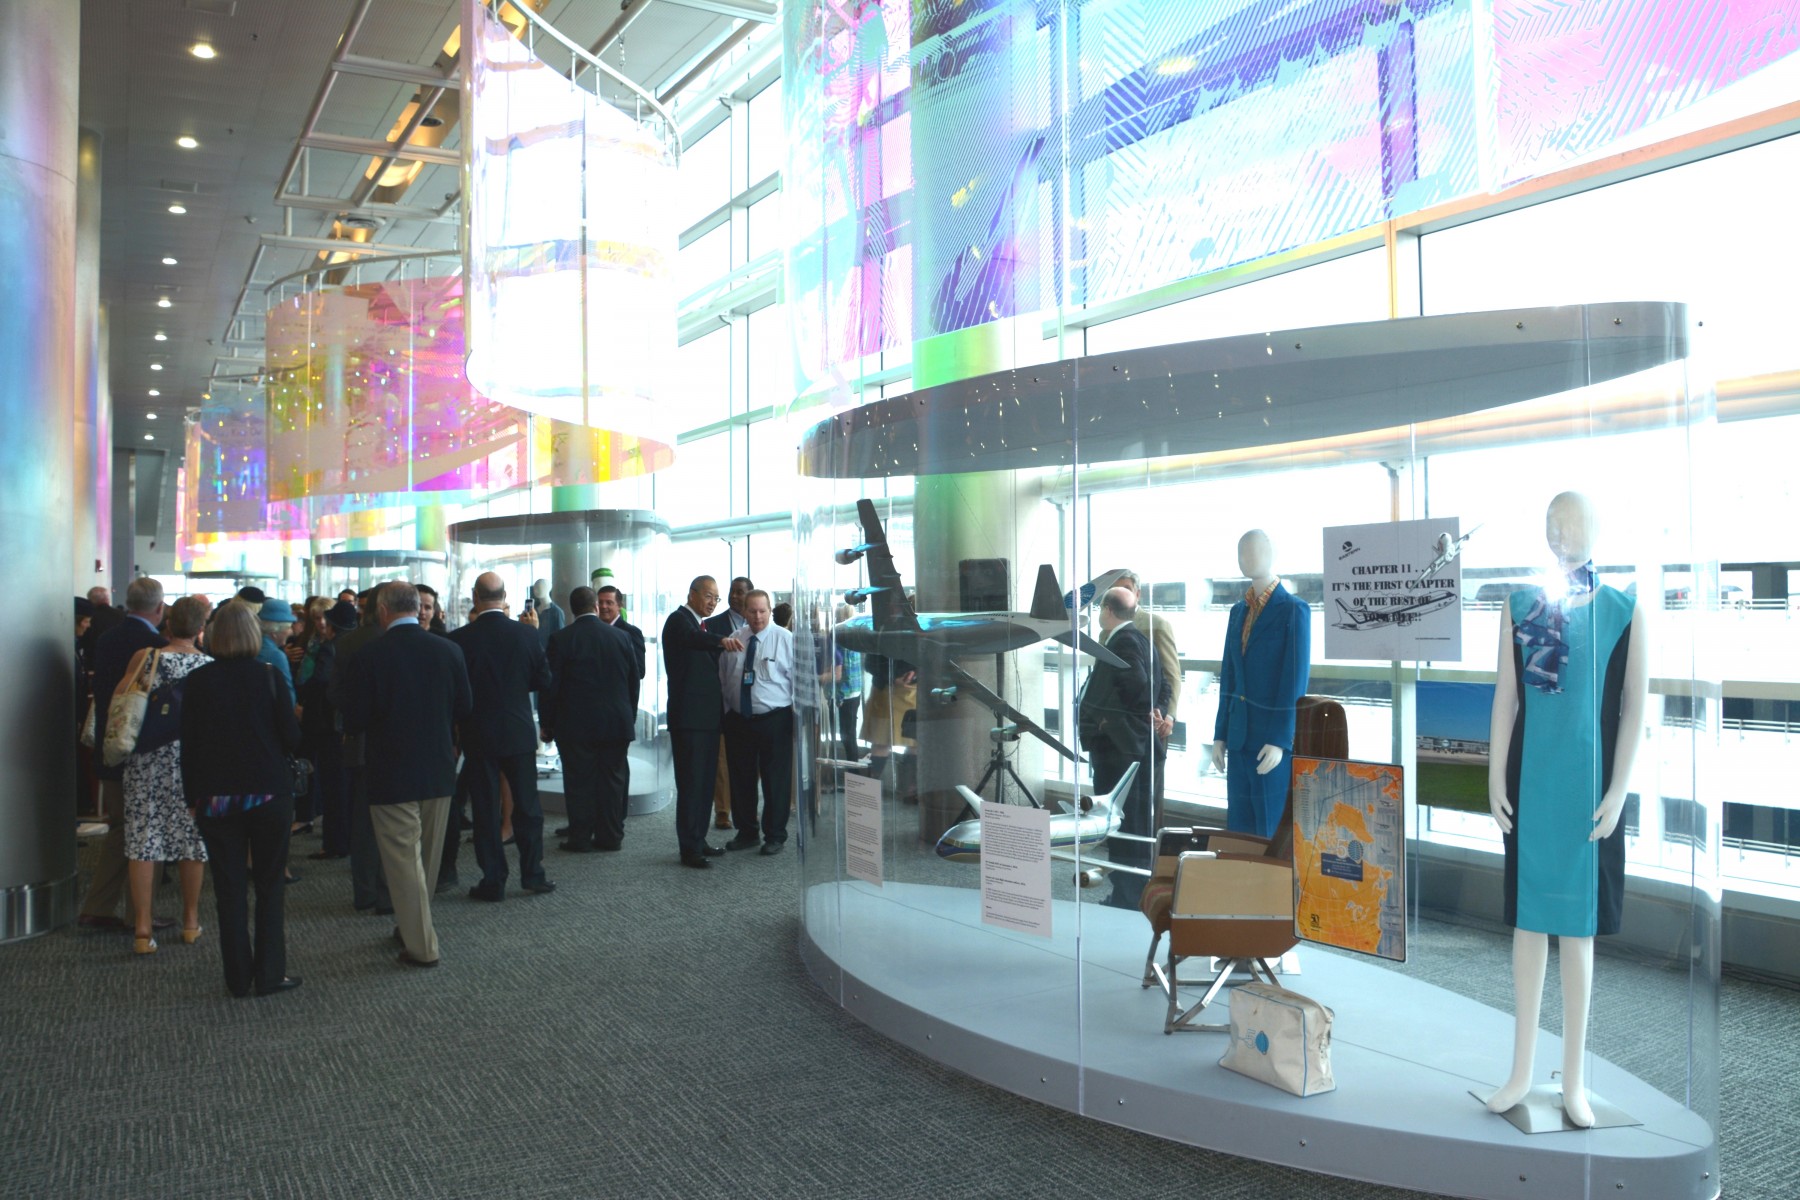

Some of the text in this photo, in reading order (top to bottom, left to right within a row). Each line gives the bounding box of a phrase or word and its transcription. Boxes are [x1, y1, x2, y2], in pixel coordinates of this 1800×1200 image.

[1352, 565, 1398, 575] CHAPTER
[1402, 564, 1411, 573] 11
[1332, 579, 1454, 591] IT'S THE FIRST CHAPTER
[1353, 595, 1432, 607] OF THE REST OF
